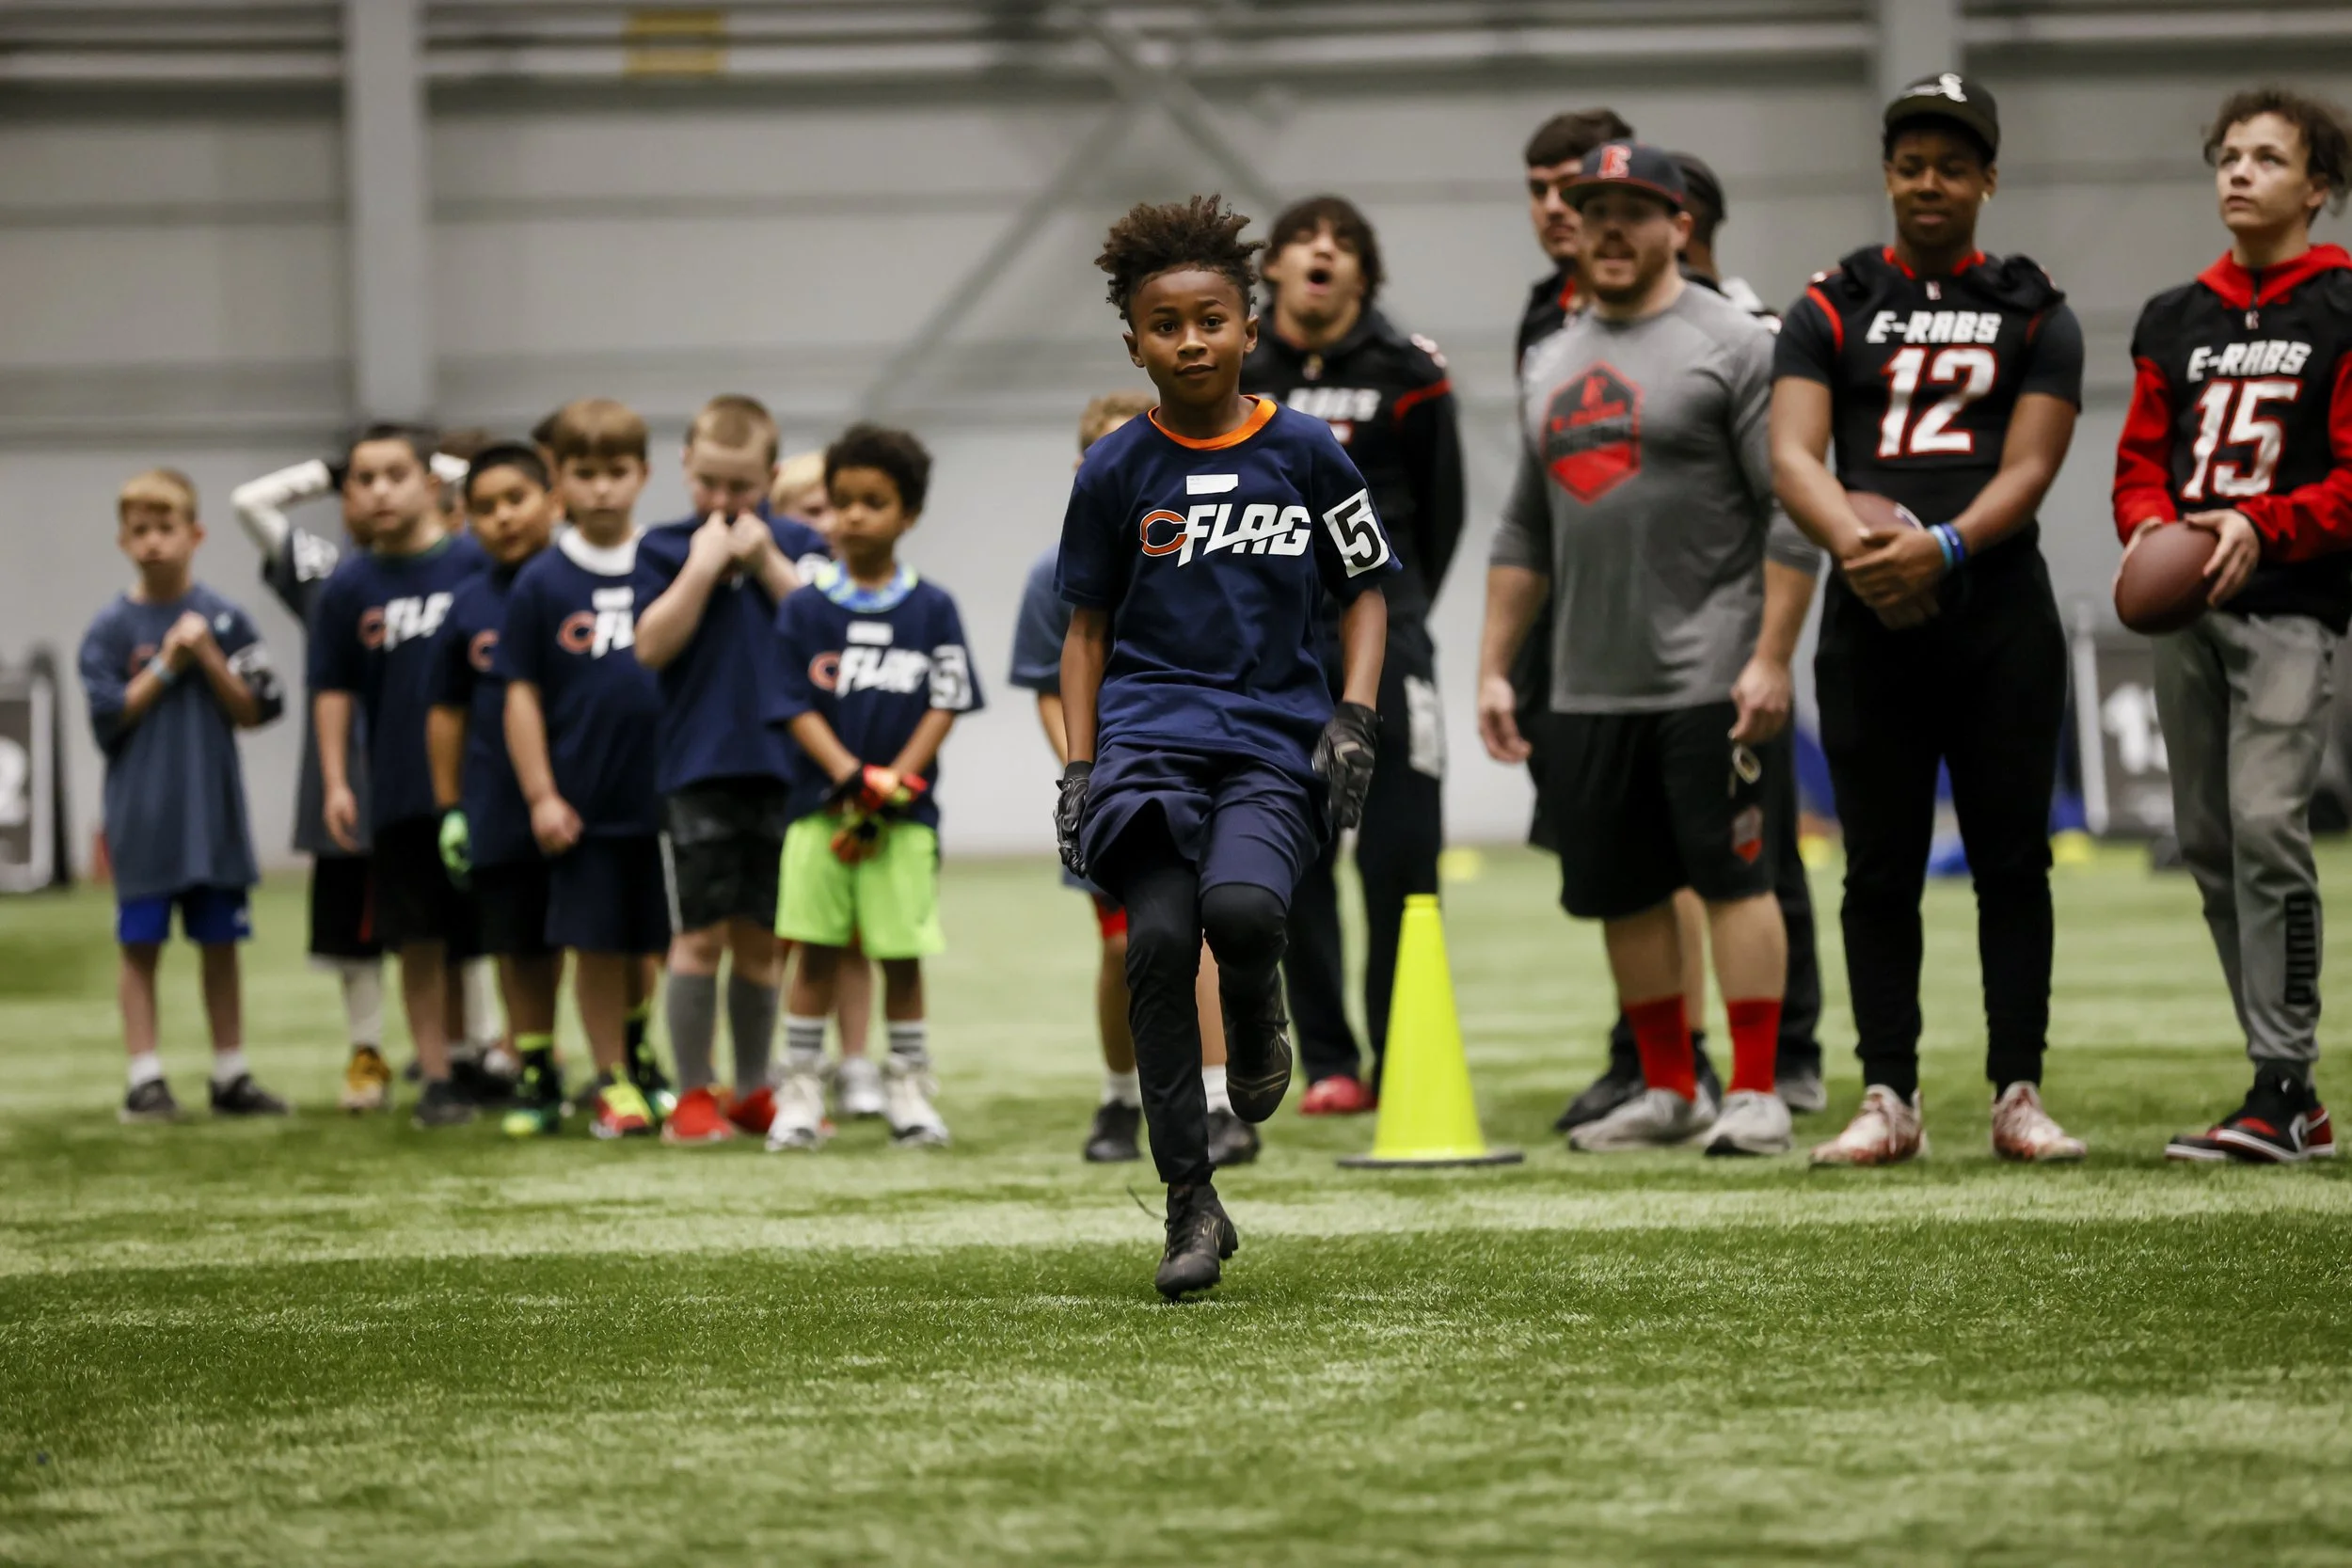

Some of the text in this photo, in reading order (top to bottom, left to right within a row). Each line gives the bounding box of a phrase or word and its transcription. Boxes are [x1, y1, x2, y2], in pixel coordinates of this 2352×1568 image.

[1866, 310, 2001, 344] E-RABS
[2186, 339, 2312, 383] E-RABS
[1876, 344, 1998, 459] 12
[2180, 378, 2301, 501] 15
[1334, 499, 1381, 568] 5
